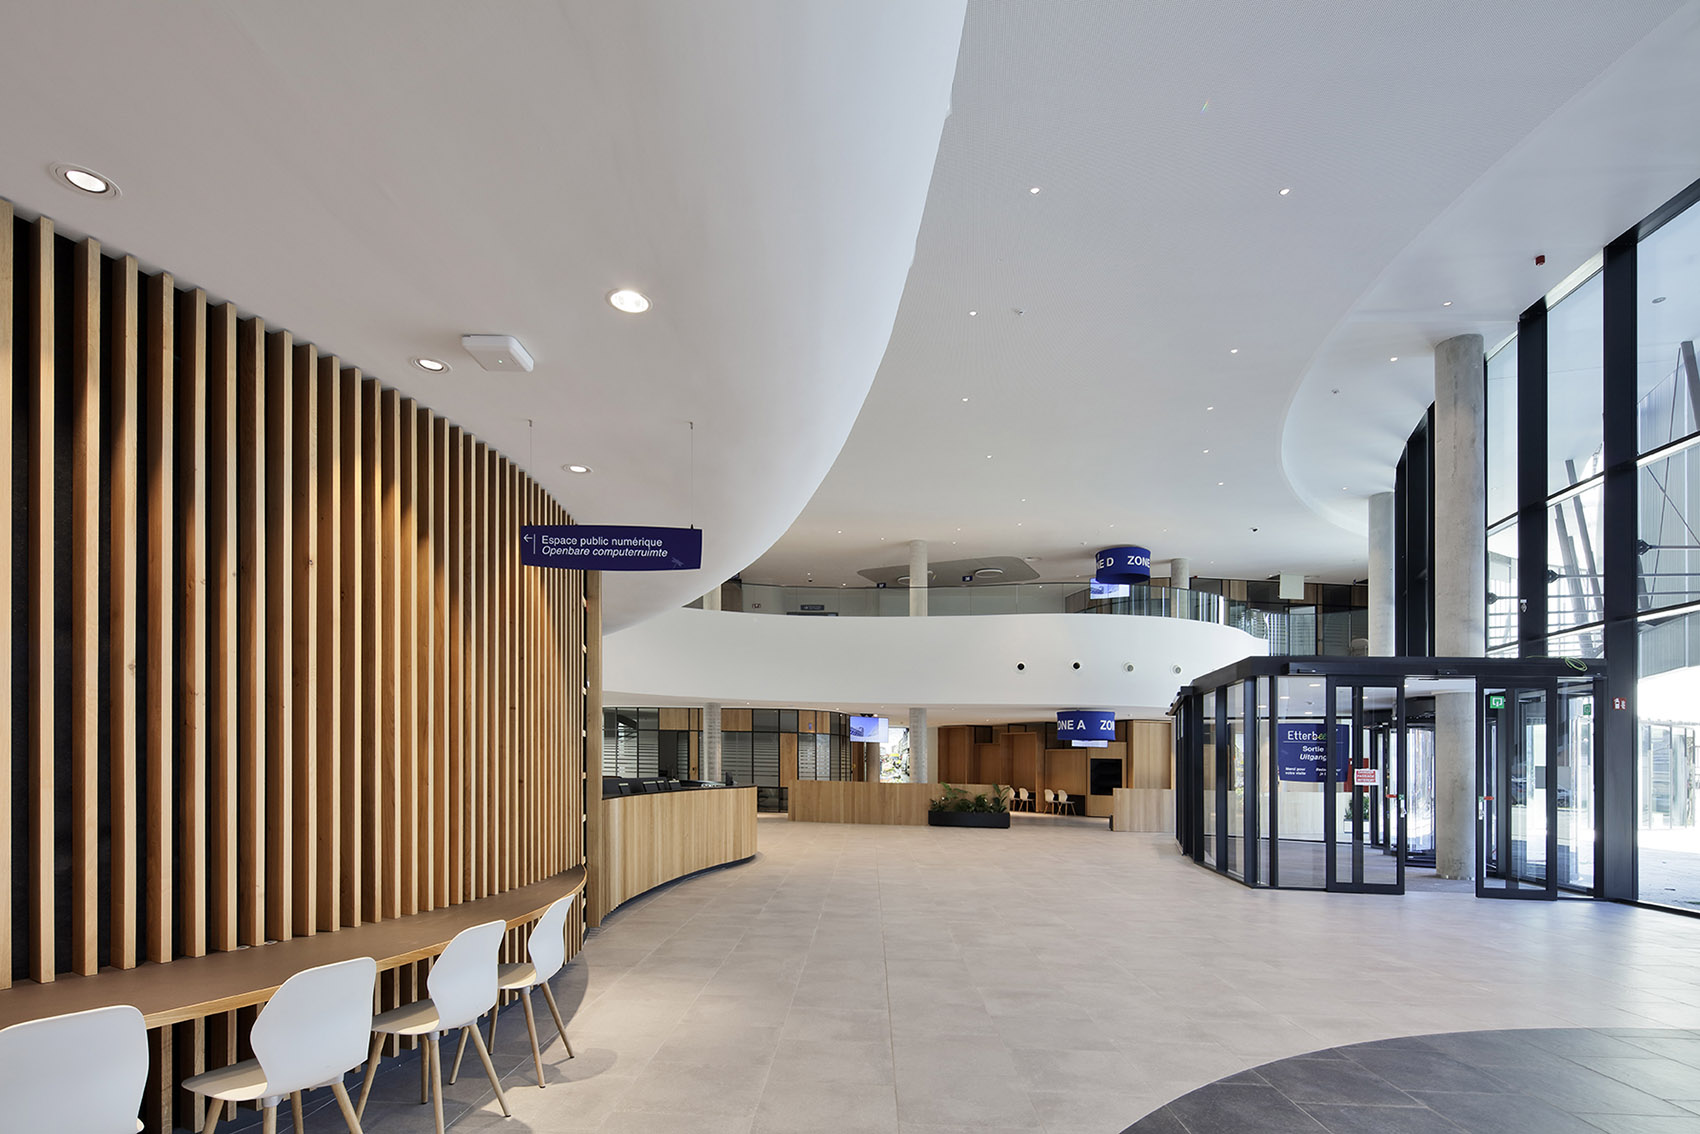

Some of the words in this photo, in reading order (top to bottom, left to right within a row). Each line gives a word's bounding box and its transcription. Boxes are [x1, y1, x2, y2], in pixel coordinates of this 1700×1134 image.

[541, 535, 578, 546] Espace
[580, 537, 609, 547] public
[611, 537, 663, 549] numérique
[541, 545, 590, 557] Openbare
[592, 548, 668, 558] computerruimte
[1106, 557, 1114, 567] D
[1076, 719, 1086, 730] A
[1302, 745, 1325, 753] Sortie
